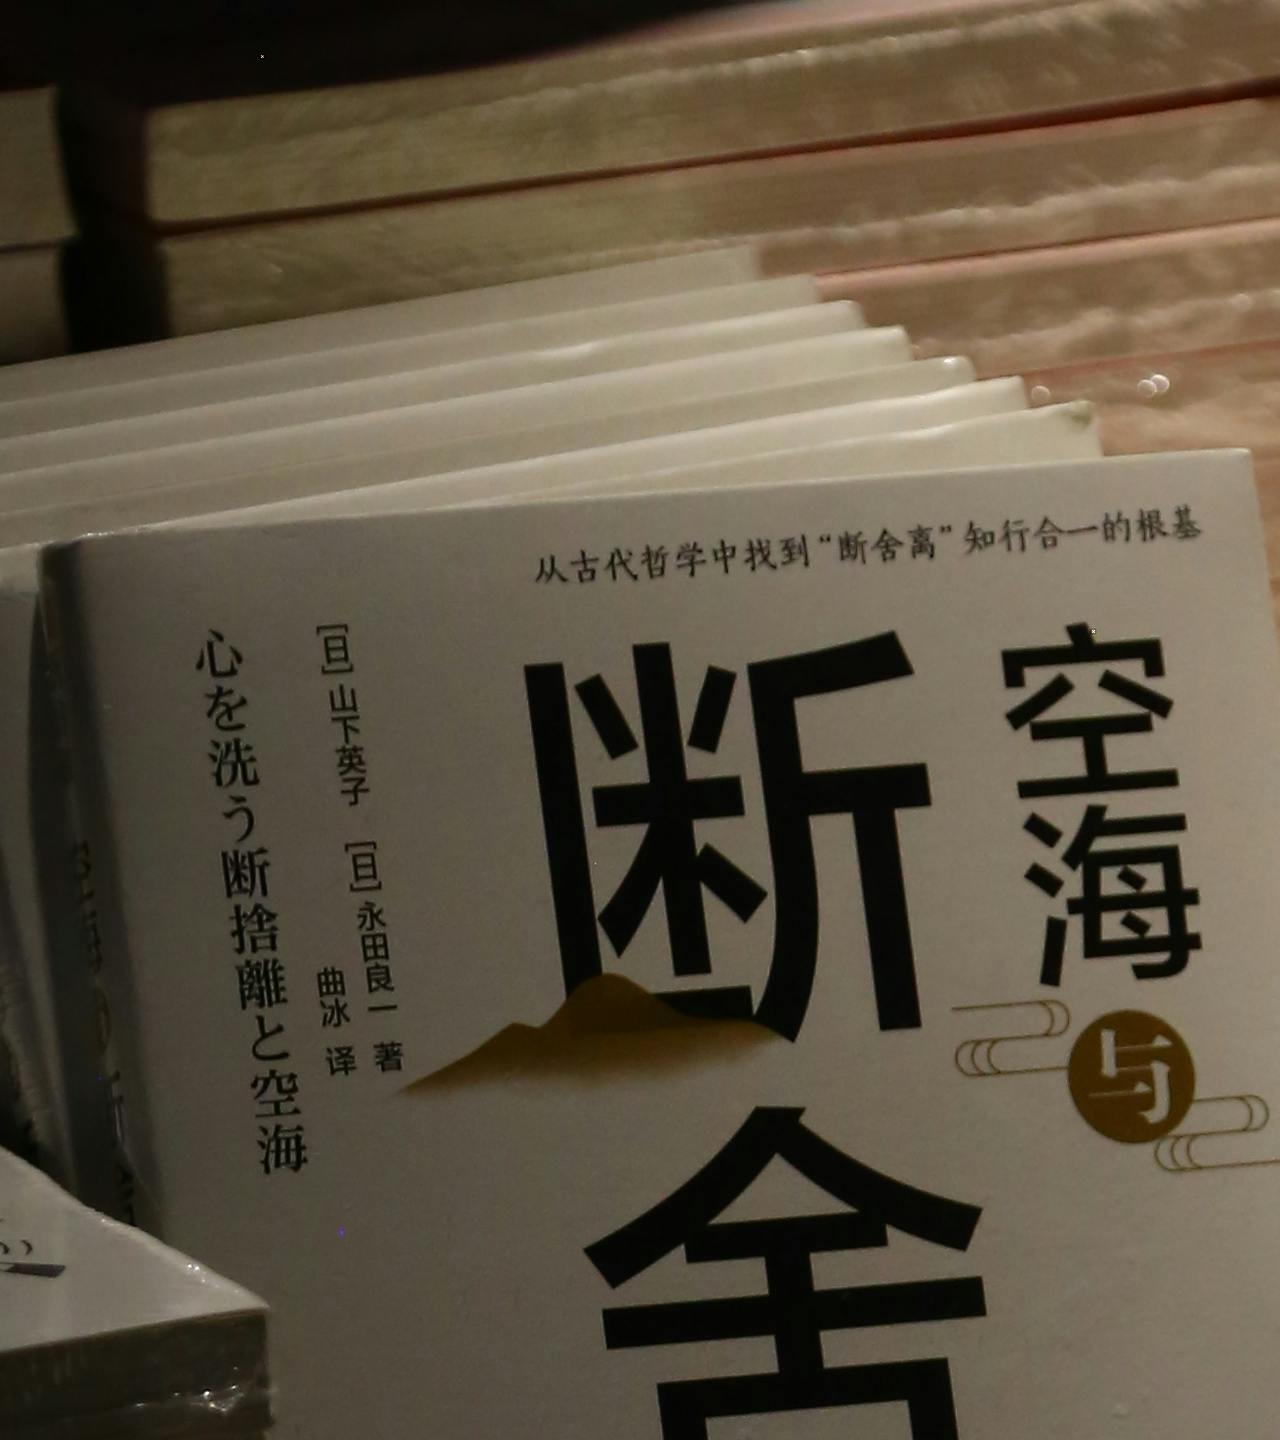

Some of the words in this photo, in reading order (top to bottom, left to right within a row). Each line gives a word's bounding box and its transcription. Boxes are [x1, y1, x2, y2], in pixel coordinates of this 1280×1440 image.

[535, 505, 1203, 584] 从古代哲学中找到“断舍离”知行合一的根基
[194, 627, 309, 1176] 心を洗う断捨離と空海
